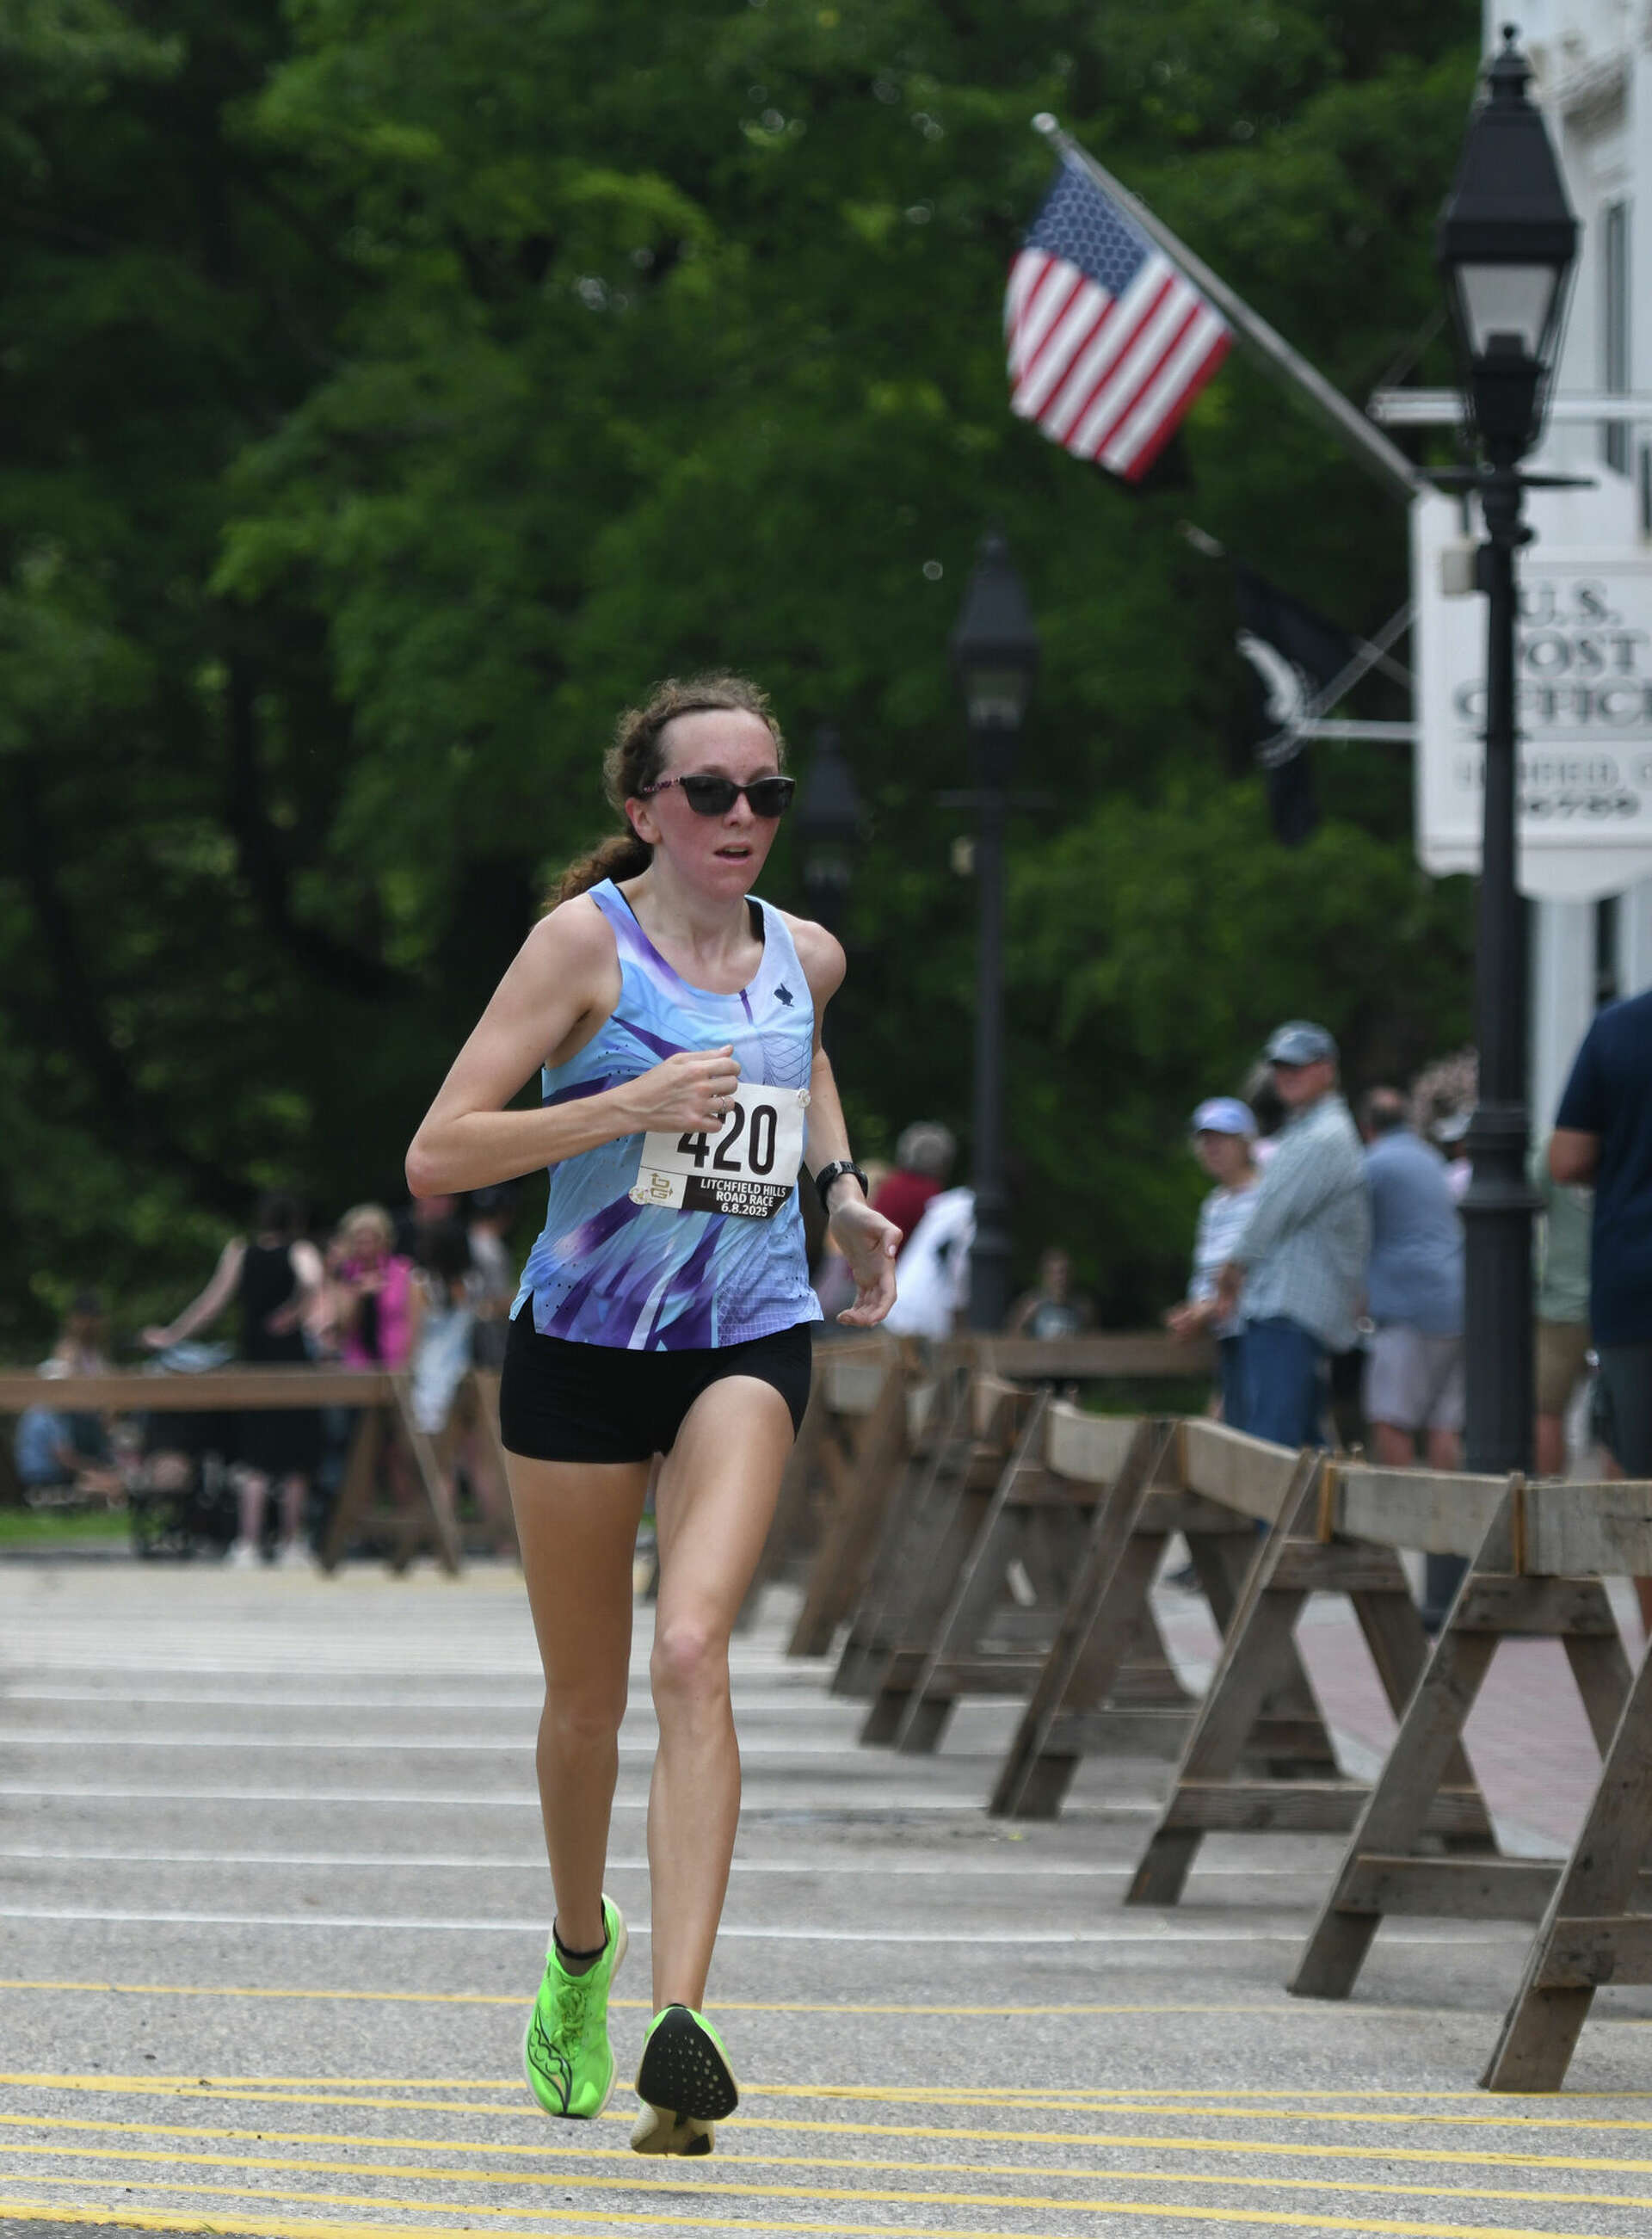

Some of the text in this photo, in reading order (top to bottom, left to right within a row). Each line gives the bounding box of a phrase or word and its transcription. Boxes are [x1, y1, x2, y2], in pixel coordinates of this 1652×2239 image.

[1516, 630, 1649, 676] OST
[677, 1101, 777, 1175] 420
[700, 1178, 786, 1197] LITCHFIELD HILLS
[716, 1191, 774, 1206] ROAD RACE
[721, 1203, 767, 1217] 6.8.2025
